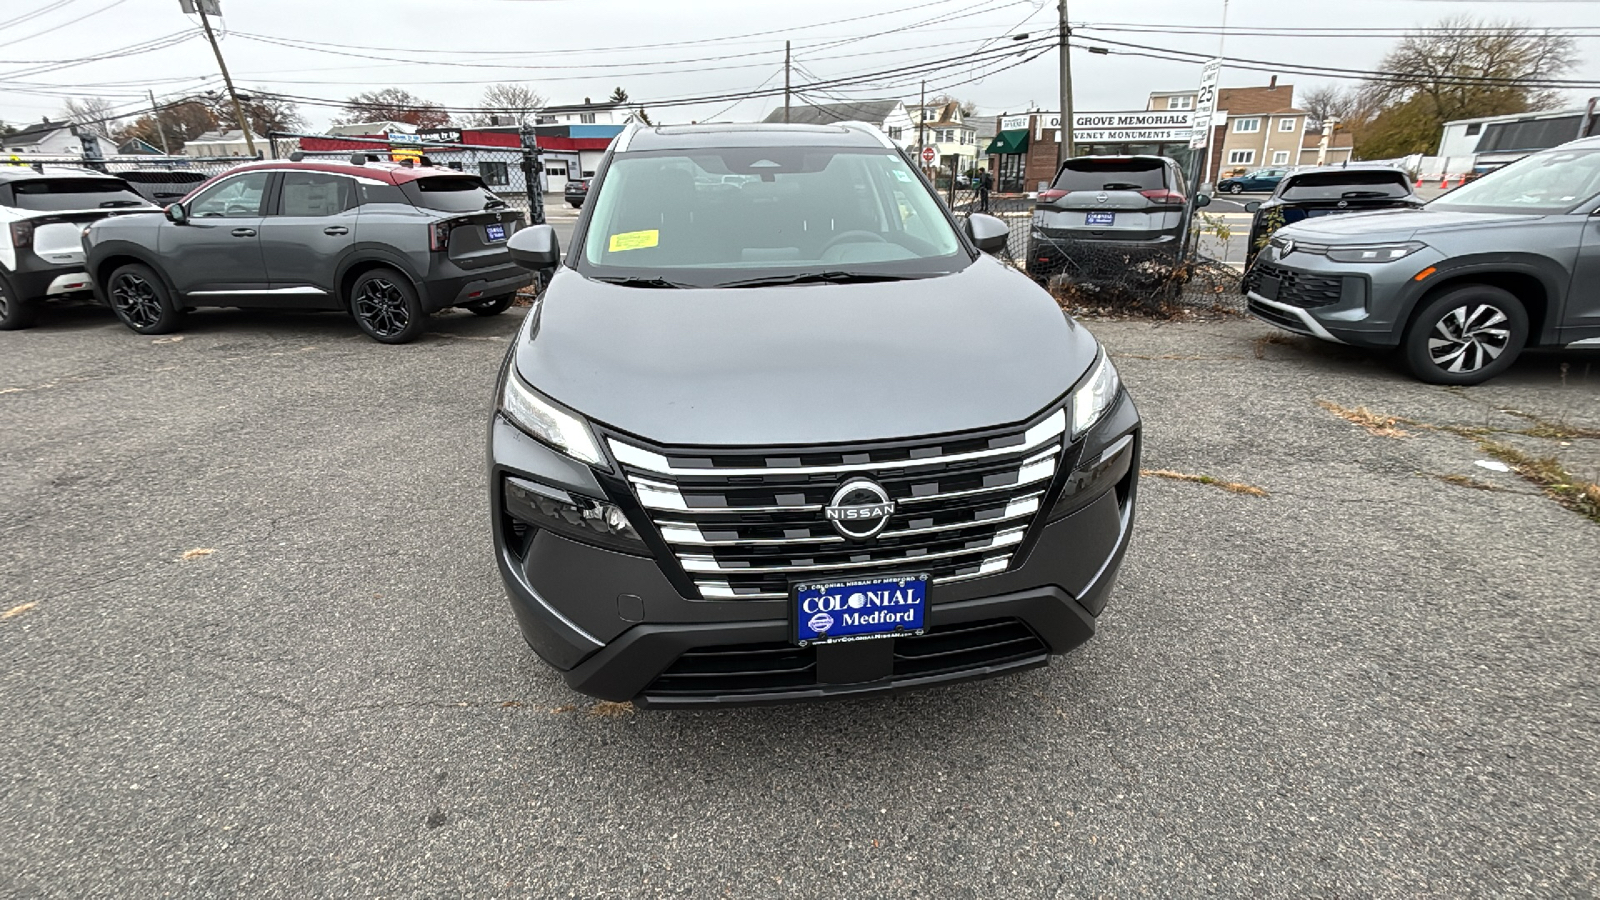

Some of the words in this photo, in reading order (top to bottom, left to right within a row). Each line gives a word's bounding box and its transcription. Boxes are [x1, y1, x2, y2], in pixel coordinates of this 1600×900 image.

[1198, 84, 1215, 103] 25
[1076, 116, 1115, 126] GROVE
[1117, 114, 1188, 125] MEMORIALS
[1073, 131, 1105, 139] VENEY
[1108, 130, 1171, 139] MONUMENTS
[826, 504, 894, 519] NISSAN
[802, 589, 920, 614] COLONIAL
[841, 608, 914, 627] Medford
